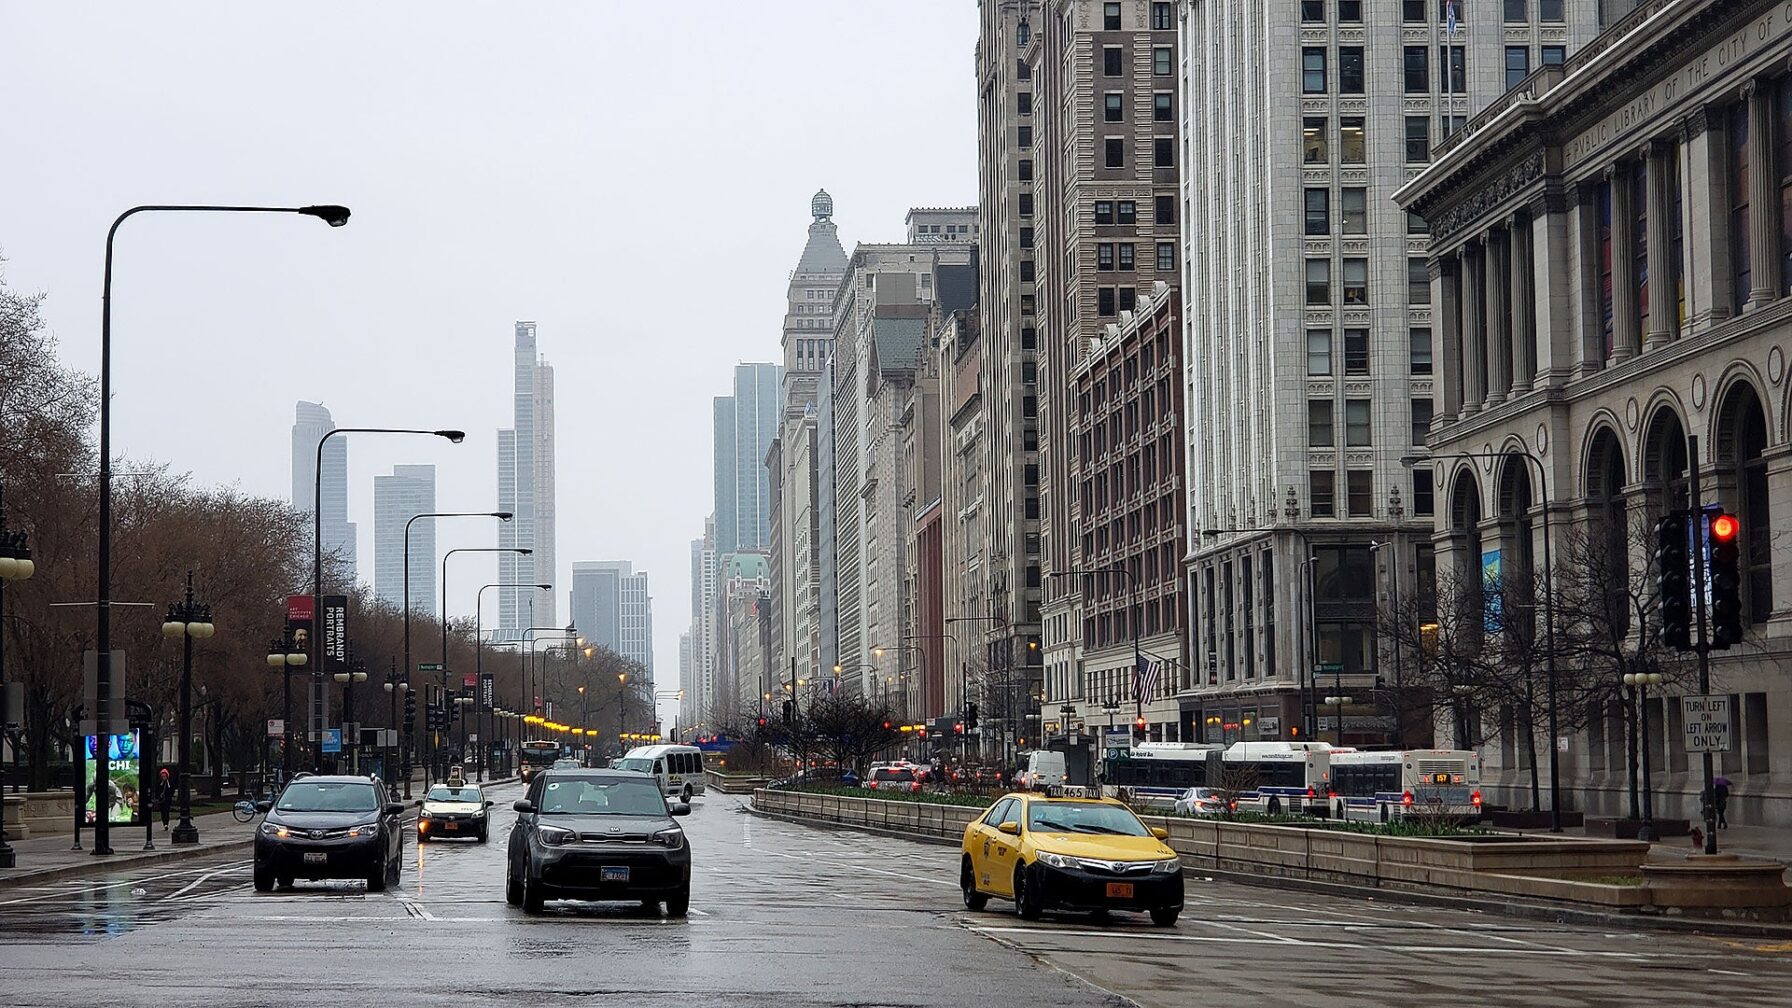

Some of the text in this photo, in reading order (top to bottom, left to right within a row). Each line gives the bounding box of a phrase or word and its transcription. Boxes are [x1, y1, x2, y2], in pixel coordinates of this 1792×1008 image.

[1614, 91, 1656, 133] LIBRARY
[1665, 78, 1678, 100] OF
[1688, 57, 1709, 85] THE
[1718, 32, 1747, 66] CITY
[1758, 16, 1773, 40] OF
[326, 607, 334, 656] PORTRAITS
[336, 607, 344, 662] REMBRANDT
[1685, 701, 1726, 712] TURN LEFT
[1701, 713, 1712, 721] ON
[1686, 722, 1727, 734] LEFT ARROW
[1693, 735, 1720, 747] ONLY
[1064, 787, 1082, 797] 465
[1086, 787, 1099, 798] TAXI
